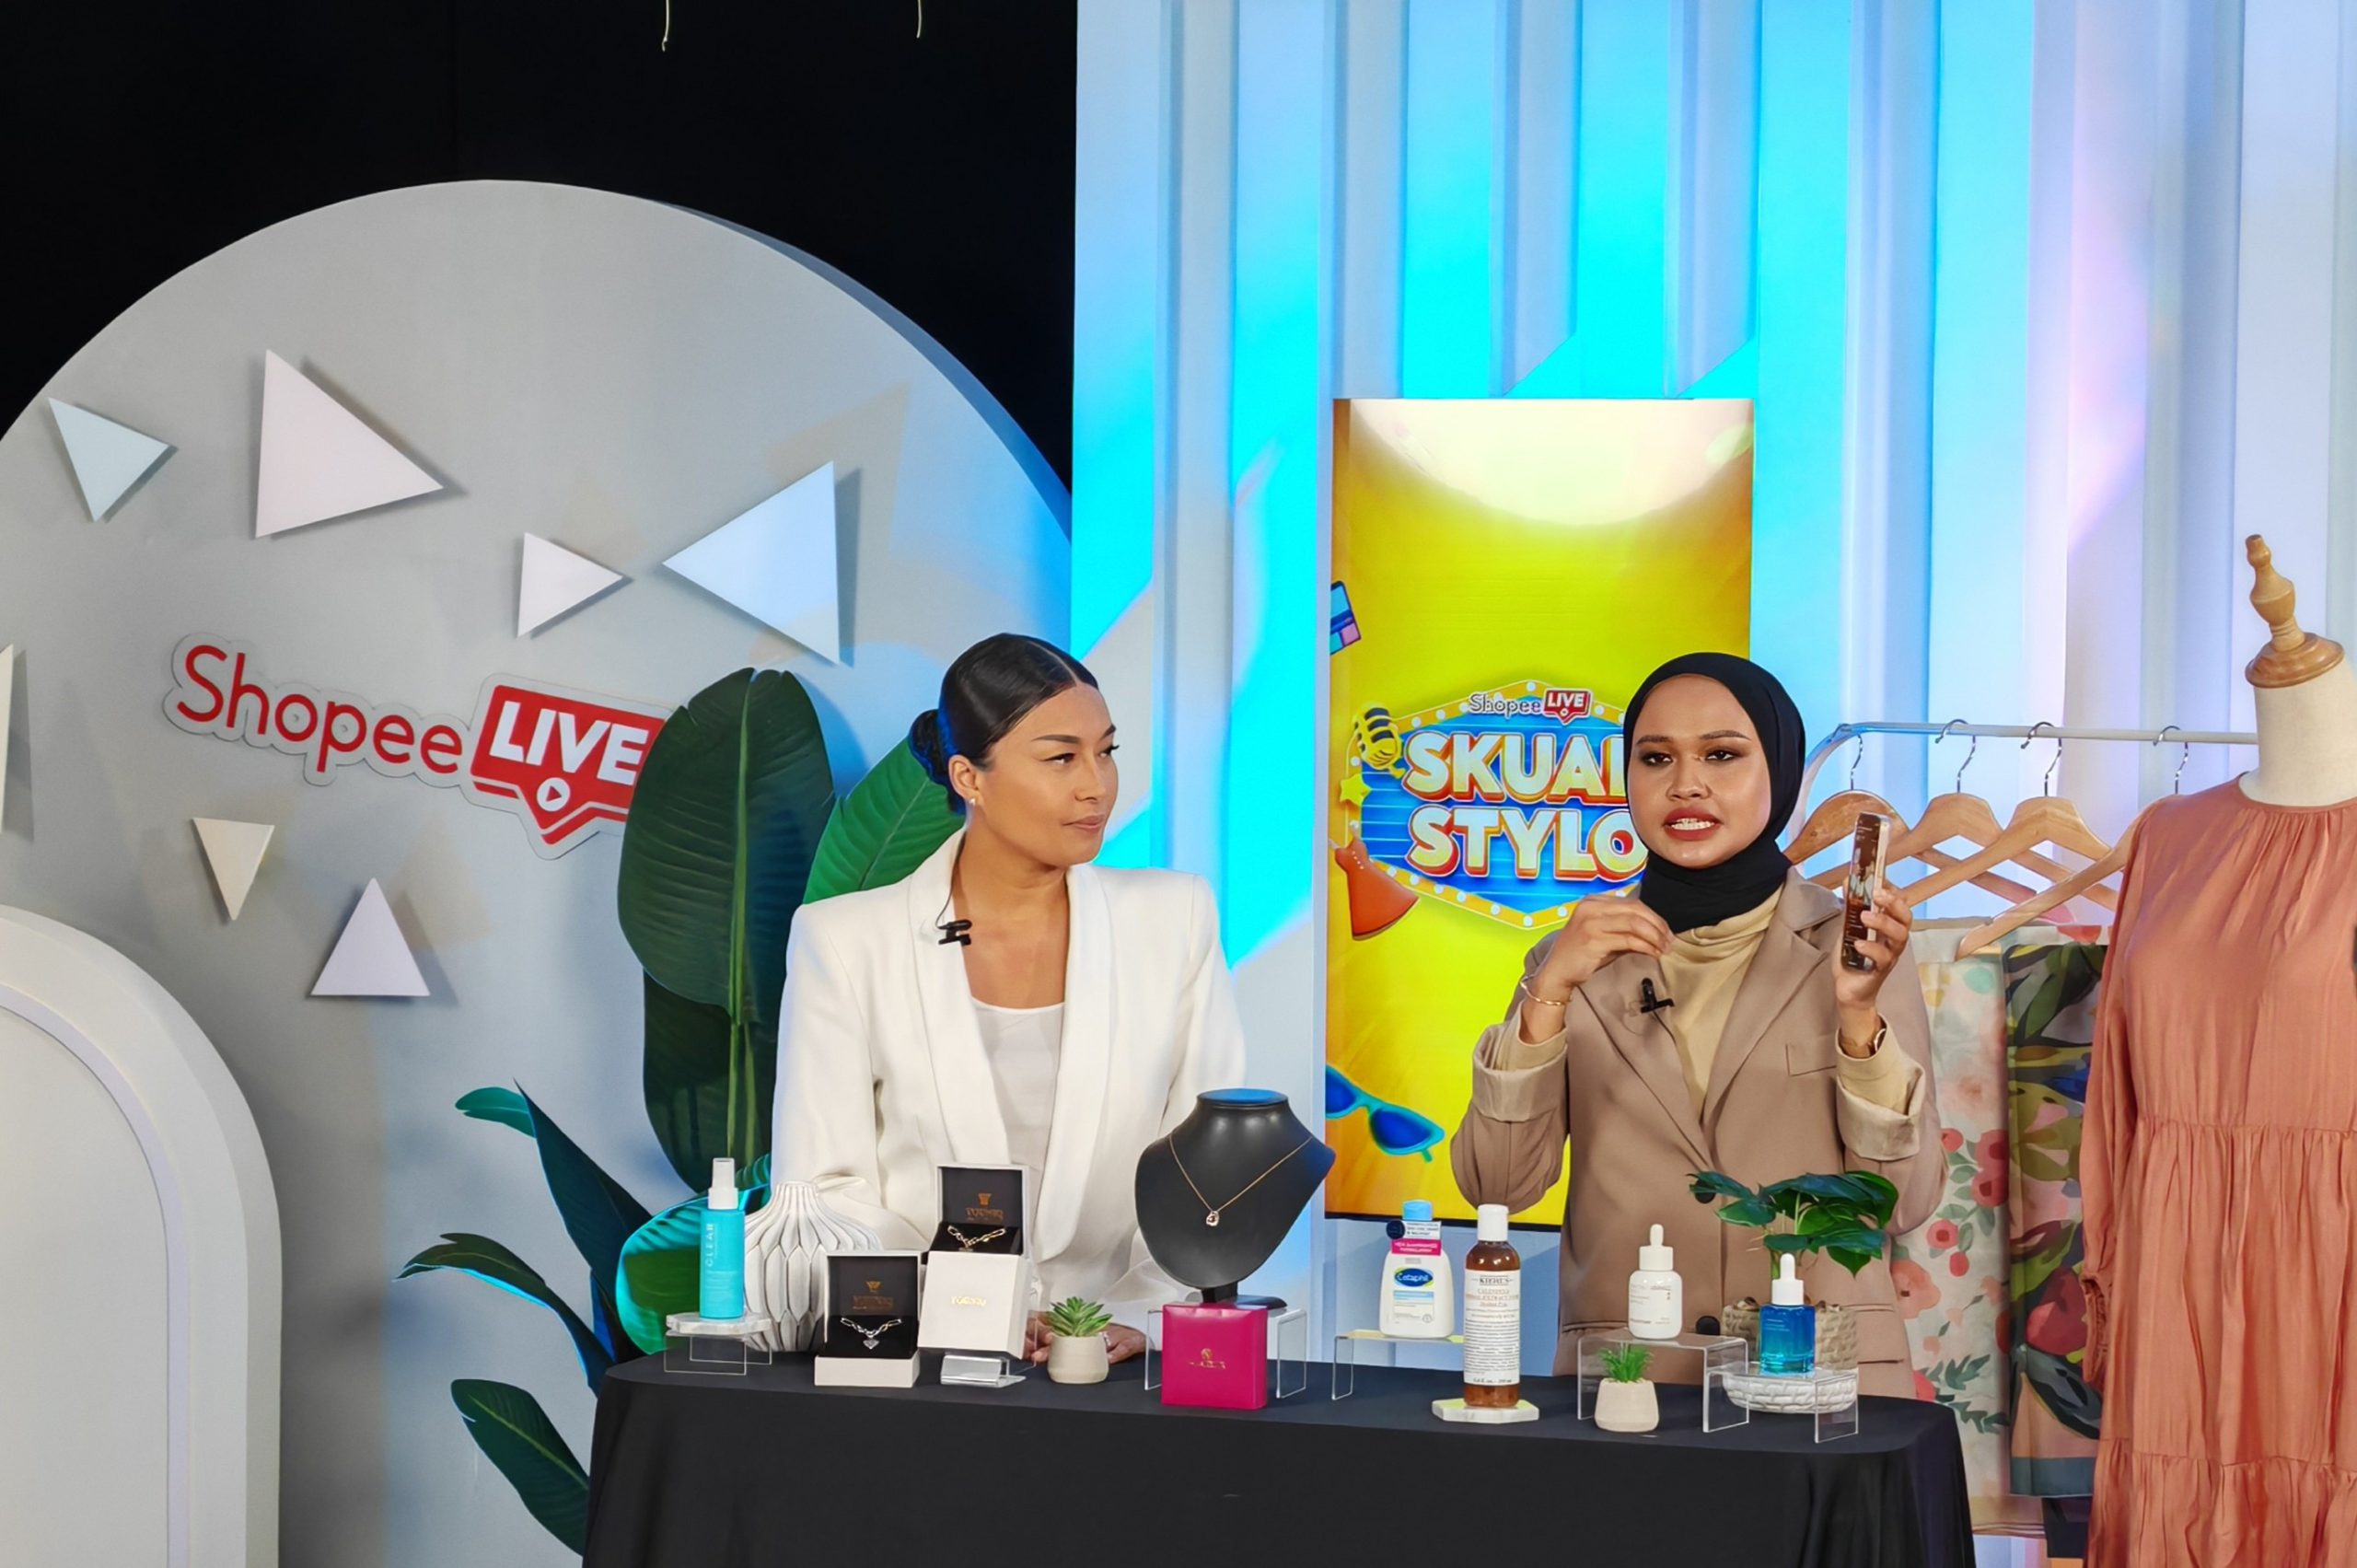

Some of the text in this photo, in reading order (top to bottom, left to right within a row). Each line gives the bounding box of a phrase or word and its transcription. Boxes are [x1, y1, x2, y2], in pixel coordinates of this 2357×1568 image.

[177, 645, 649, 785] Shopee LIVE
[1469, 691, 1585, 717] Shopee LIVE
[1406, 806, 1649, 881] STYLO
